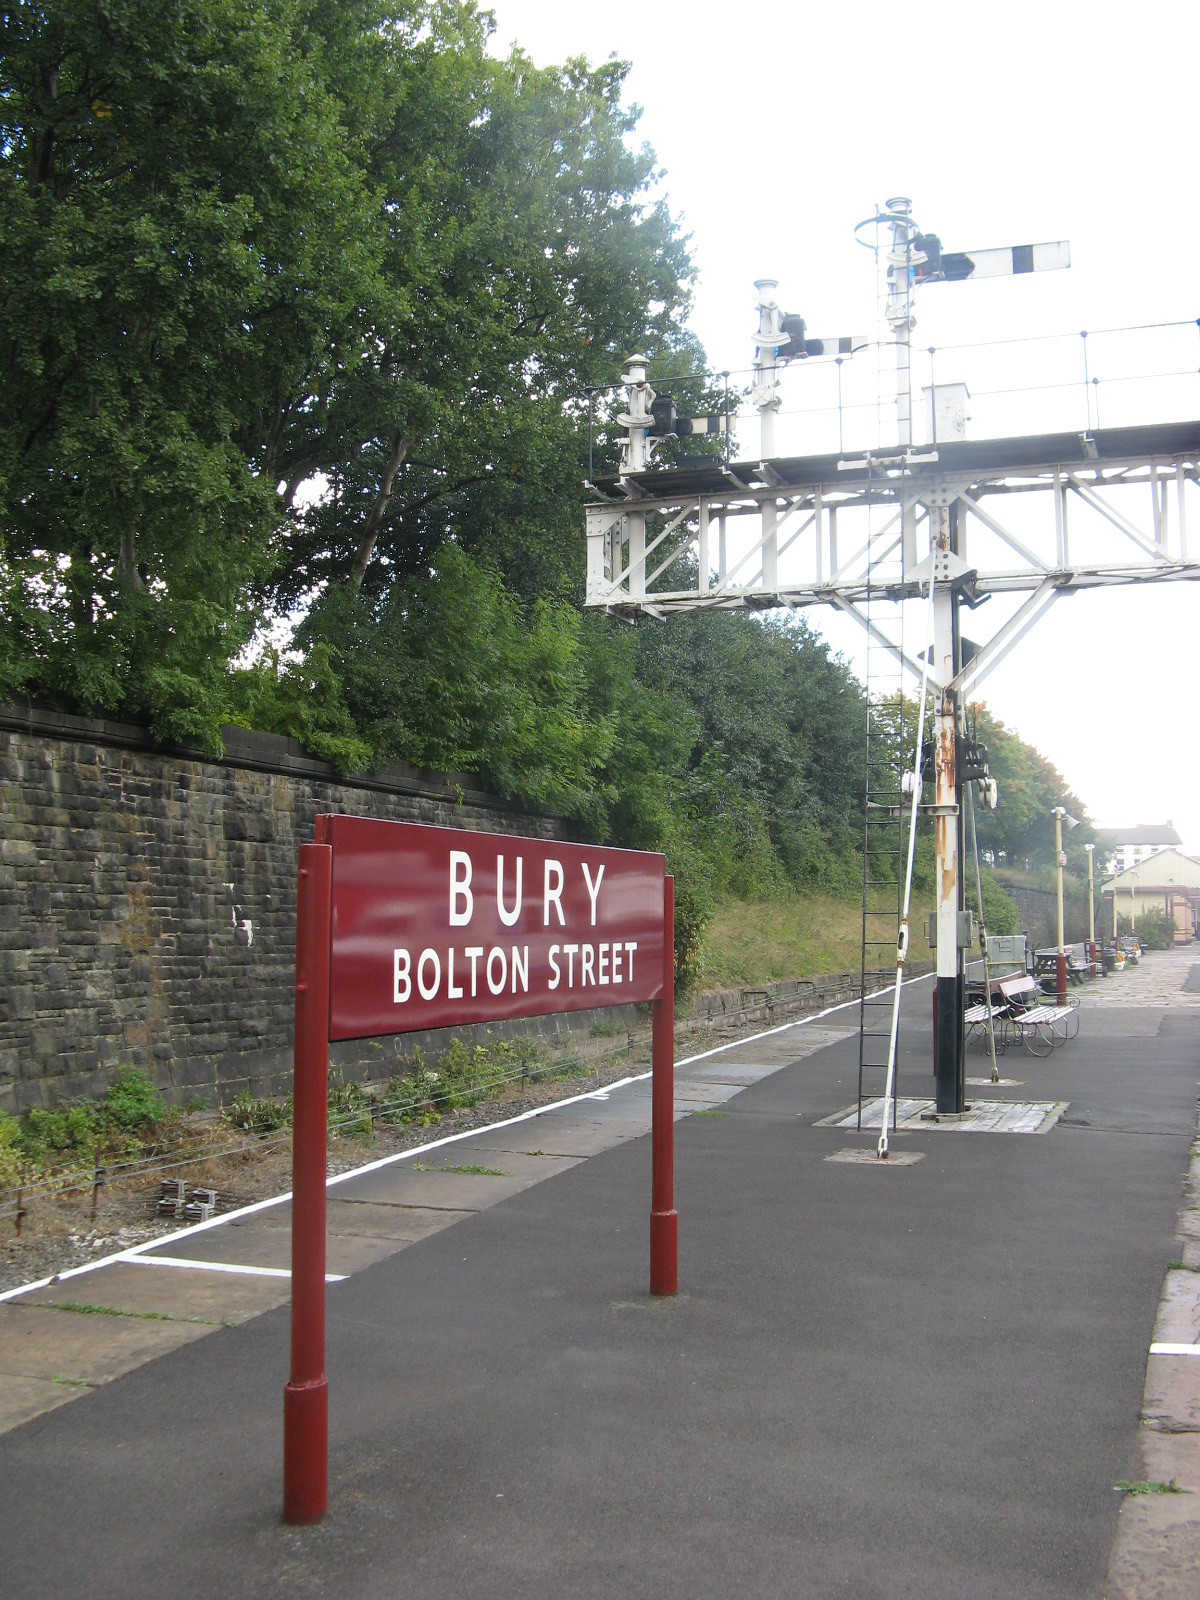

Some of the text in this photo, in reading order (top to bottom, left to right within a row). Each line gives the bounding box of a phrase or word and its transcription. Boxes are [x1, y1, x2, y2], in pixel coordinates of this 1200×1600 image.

[449, 850, 606, 927] BURY
[393, 941, 638, 1004] BOLTON STREET
